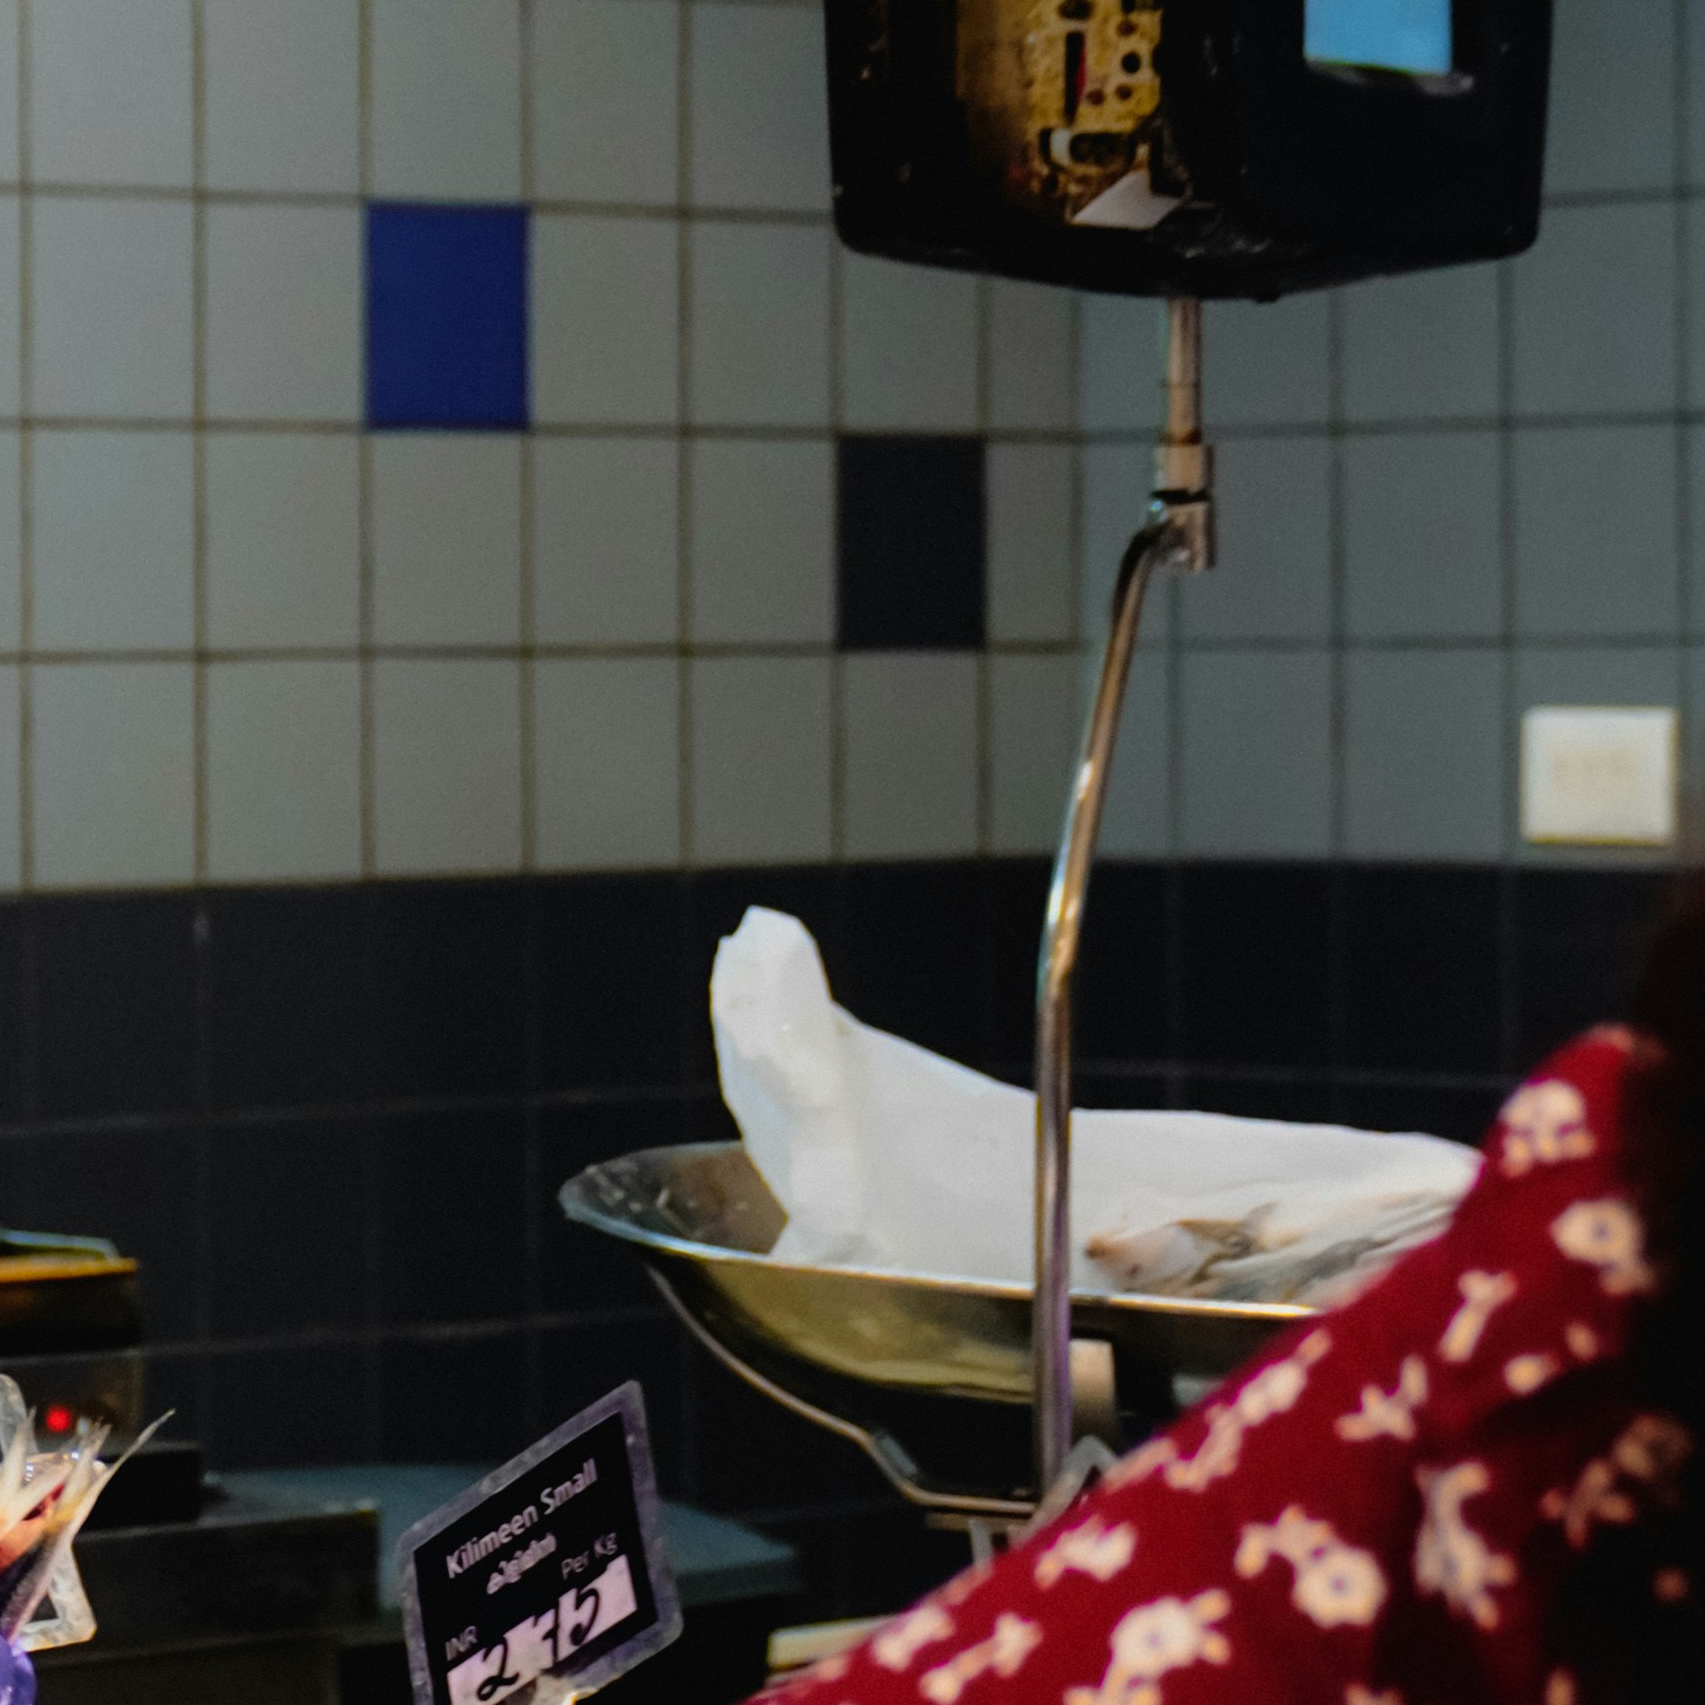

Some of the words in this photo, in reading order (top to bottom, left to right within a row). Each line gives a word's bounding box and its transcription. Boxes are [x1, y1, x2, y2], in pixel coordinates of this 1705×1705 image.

[446, 1505, 539, 1579] Kilimeen
[540, 1457, 598, 1515] Small
[561, 1550, 590, 1581] Per
[594, 1532, 618, 1559] Kg
[445, 1625, 478, 1661] INR
